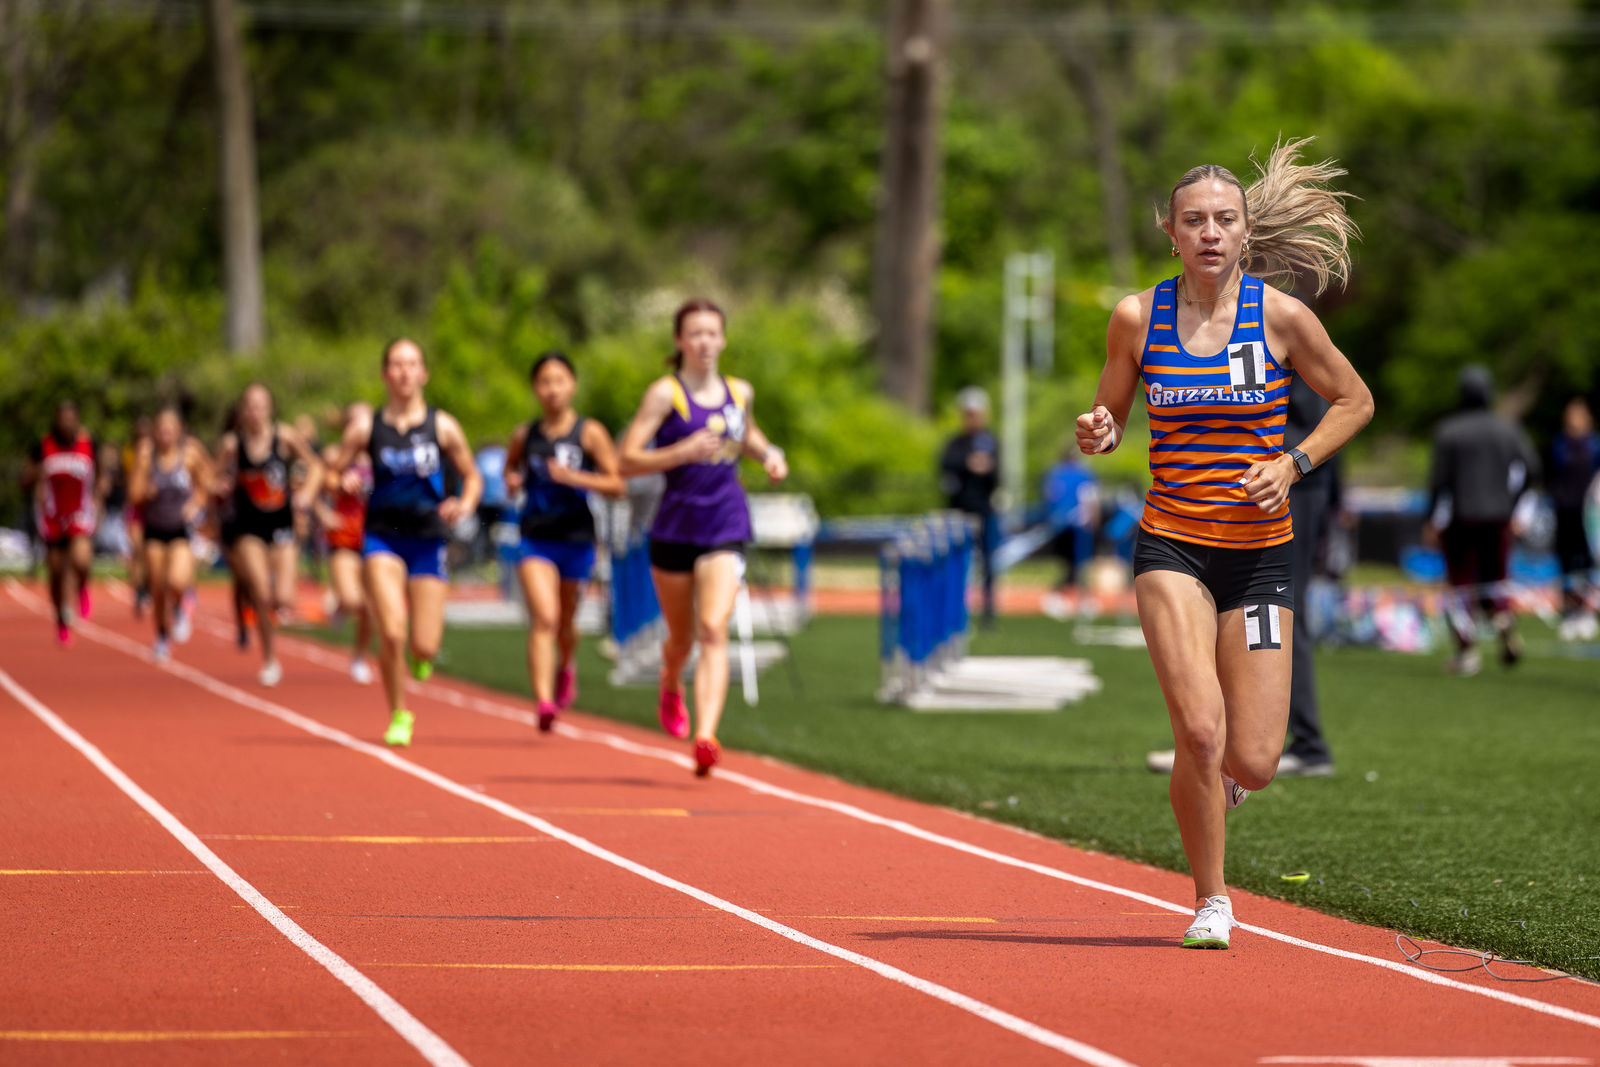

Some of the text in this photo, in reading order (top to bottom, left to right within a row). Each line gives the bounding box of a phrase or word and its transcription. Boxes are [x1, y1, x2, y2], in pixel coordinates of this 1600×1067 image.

[1230, 343, 1266, 391] 1
[1149, 382, 1266, 406] GRIZZLIES
[1246, 605, 1282, 651] 1
